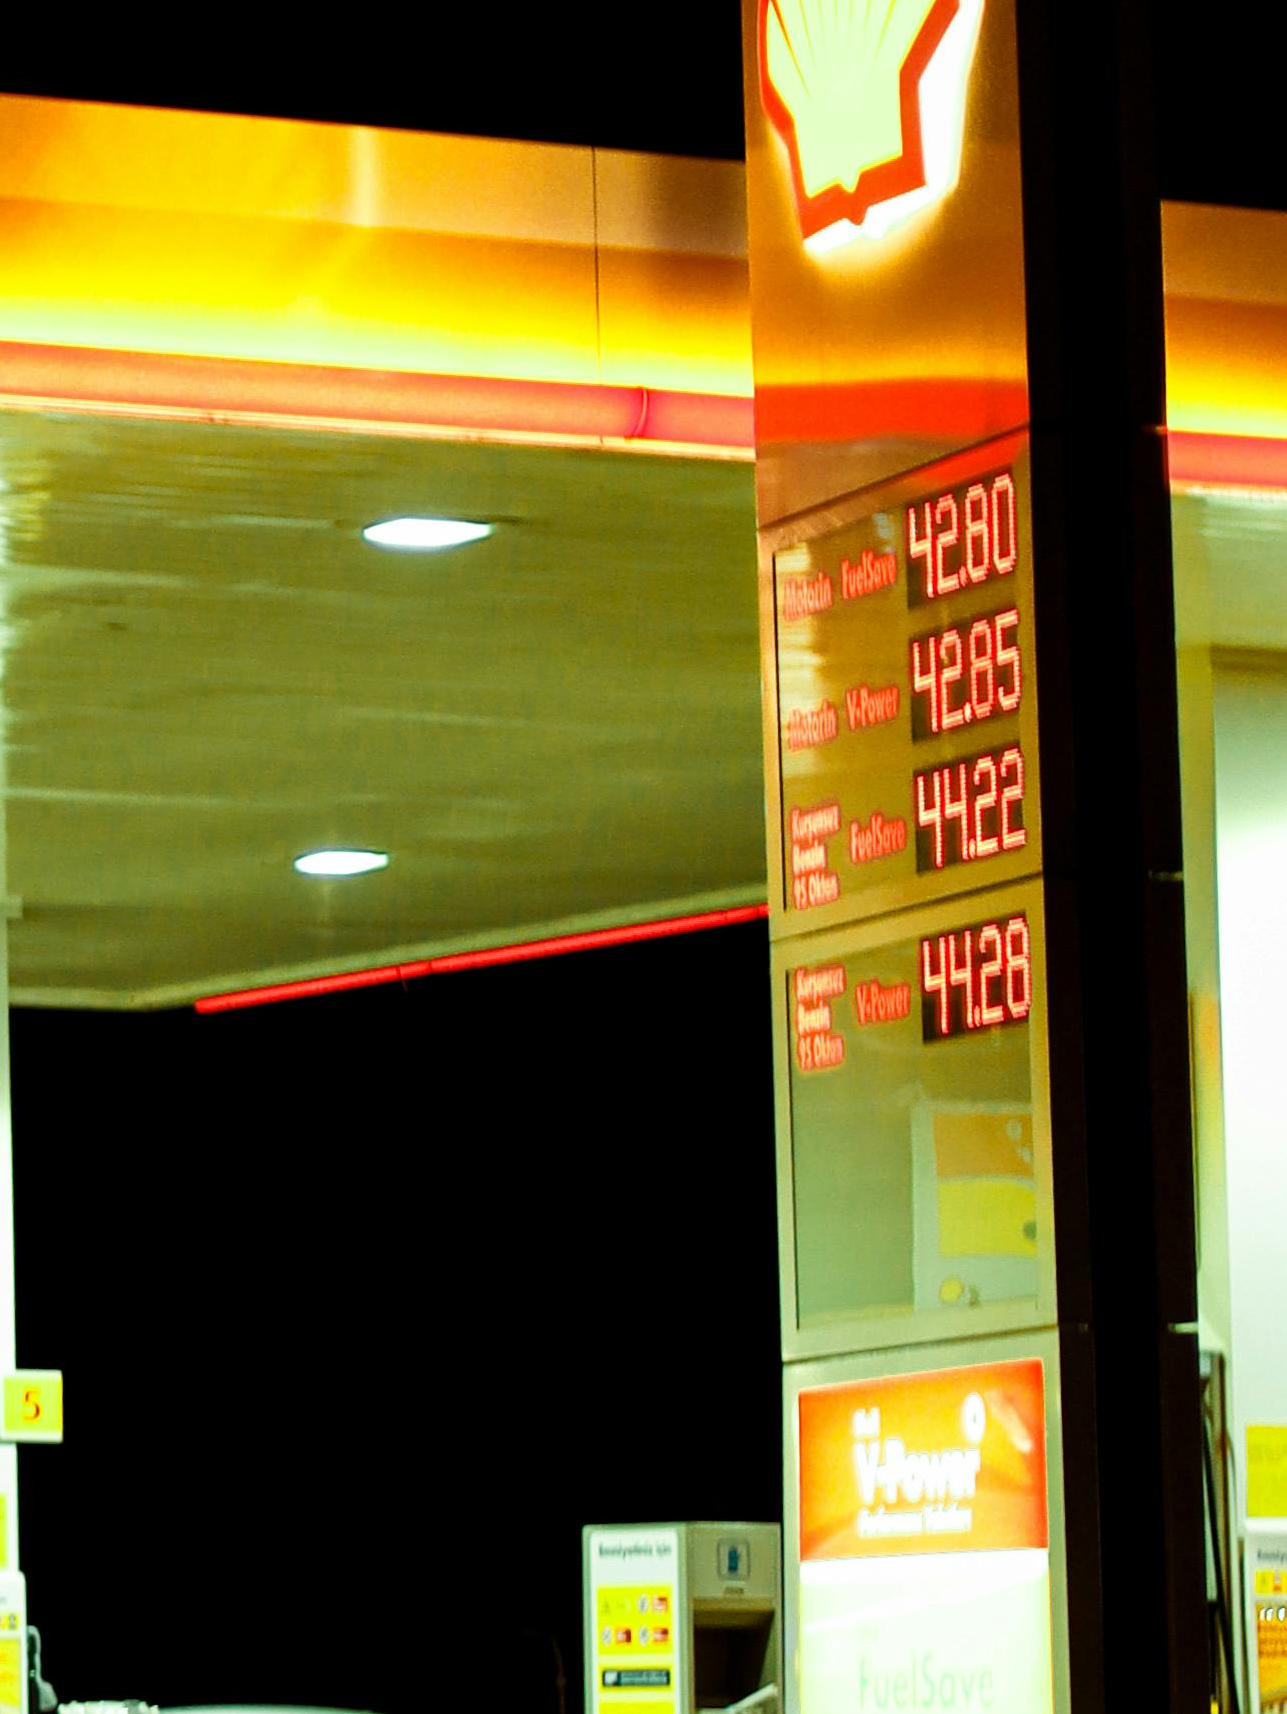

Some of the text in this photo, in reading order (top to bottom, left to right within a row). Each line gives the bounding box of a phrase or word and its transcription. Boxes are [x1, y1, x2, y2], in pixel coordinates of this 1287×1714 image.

[784, 473, 1017, 621] Motorin FuelSave 42.80
[788, 608, 1021, 750] Motorin V-Power 42.85
[850, 747, 1027, 868] FuelSave 44.22
[855, 917, 1031, 1035] V-Power 44.28
[22, 1389, 41, 1421] 5
[859, 1648, 995, 1711] FuelSave
